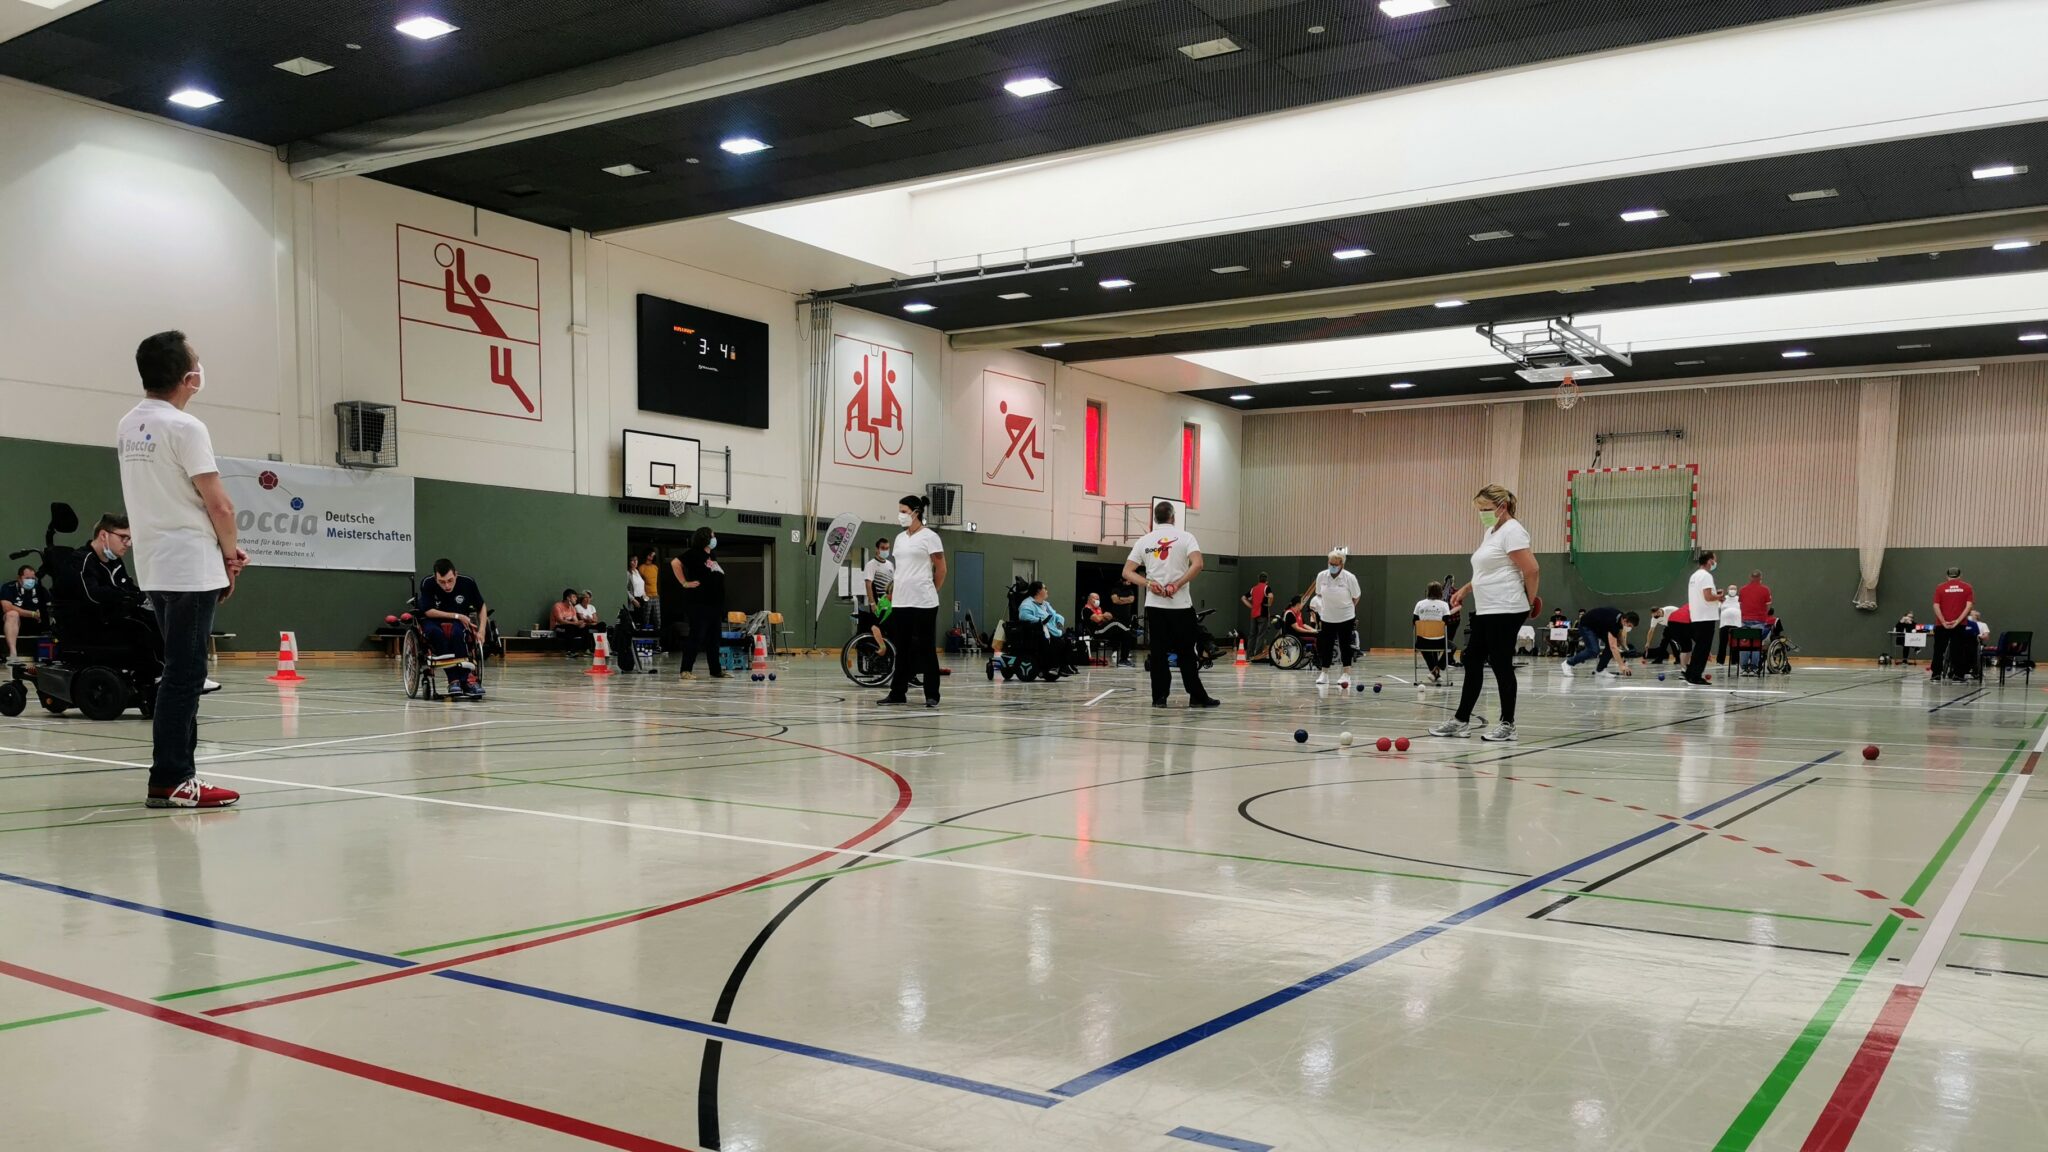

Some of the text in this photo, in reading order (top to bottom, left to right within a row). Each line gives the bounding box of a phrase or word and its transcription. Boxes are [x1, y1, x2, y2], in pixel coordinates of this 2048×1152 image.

[720, 343, 728, 359] 4
[125, 439, 156, 453] Boccia
[236, 509, 318, 535] occia
[325, 511, 375, 524] Deutsche
[326, 527, 412, 541] Meisterschaften
